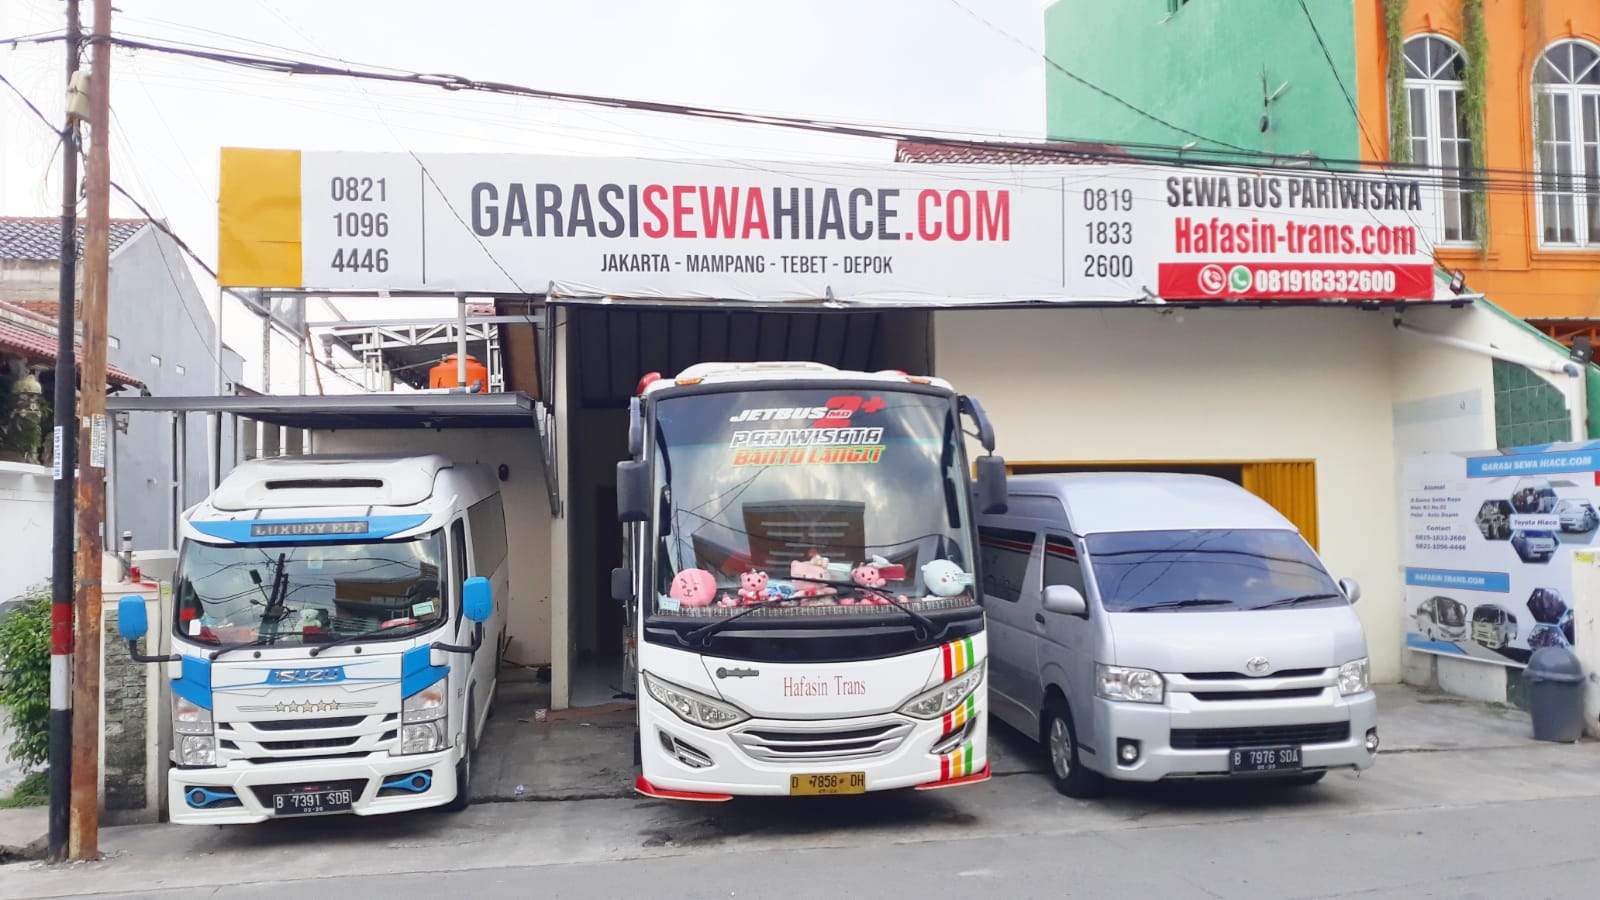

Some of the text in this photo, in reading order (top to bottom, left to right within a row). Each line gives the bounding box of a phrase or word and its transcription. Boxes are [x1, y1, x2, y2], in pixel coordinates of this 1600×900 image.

[331, 176, 387, 202] 0821
[1083, 187, 1133, 212] 0819
[1166, 176, 1422, 211] SEWA BUS PARIWISATA
[471, 181, 1010, 242] GARASISEWAHIACE.COM
[333, 212, 389, 238] 1096
[1084, 221, 1133, 245] 1833
[1174, 216, 1416, 256] Hafasin-trans.com
[331, 247, 389, 273] 4446
[601, 254, 670, 273] JAKARTA
[686, 254, 765, 273] MAMPANG
[781, 255, 827, 274] TEBET
[844, 255, 893, 275] DEPOK
[1084, 254, 1134, 278] 2600
[1255, 269, 1396, 293] 081918332600
[730, 407, 828, 422] JETBUS
[730, 427, 884, 449] PARIWISATA
[1481, 462, 1512, 472] GARASI
[1514, 460, 1538, 470] SEWA
[255, 522, 365, 536] LUXURY ELF
[274, 668, 340, 683] ISUZU
[784, 675, 866, 697] Hafasin Trans
[1234, 750, 1298, 765] B 7976 SDA
[811, 775, 838, 788] 7858
[276, 792, 349, 808] B 7391 SDB
